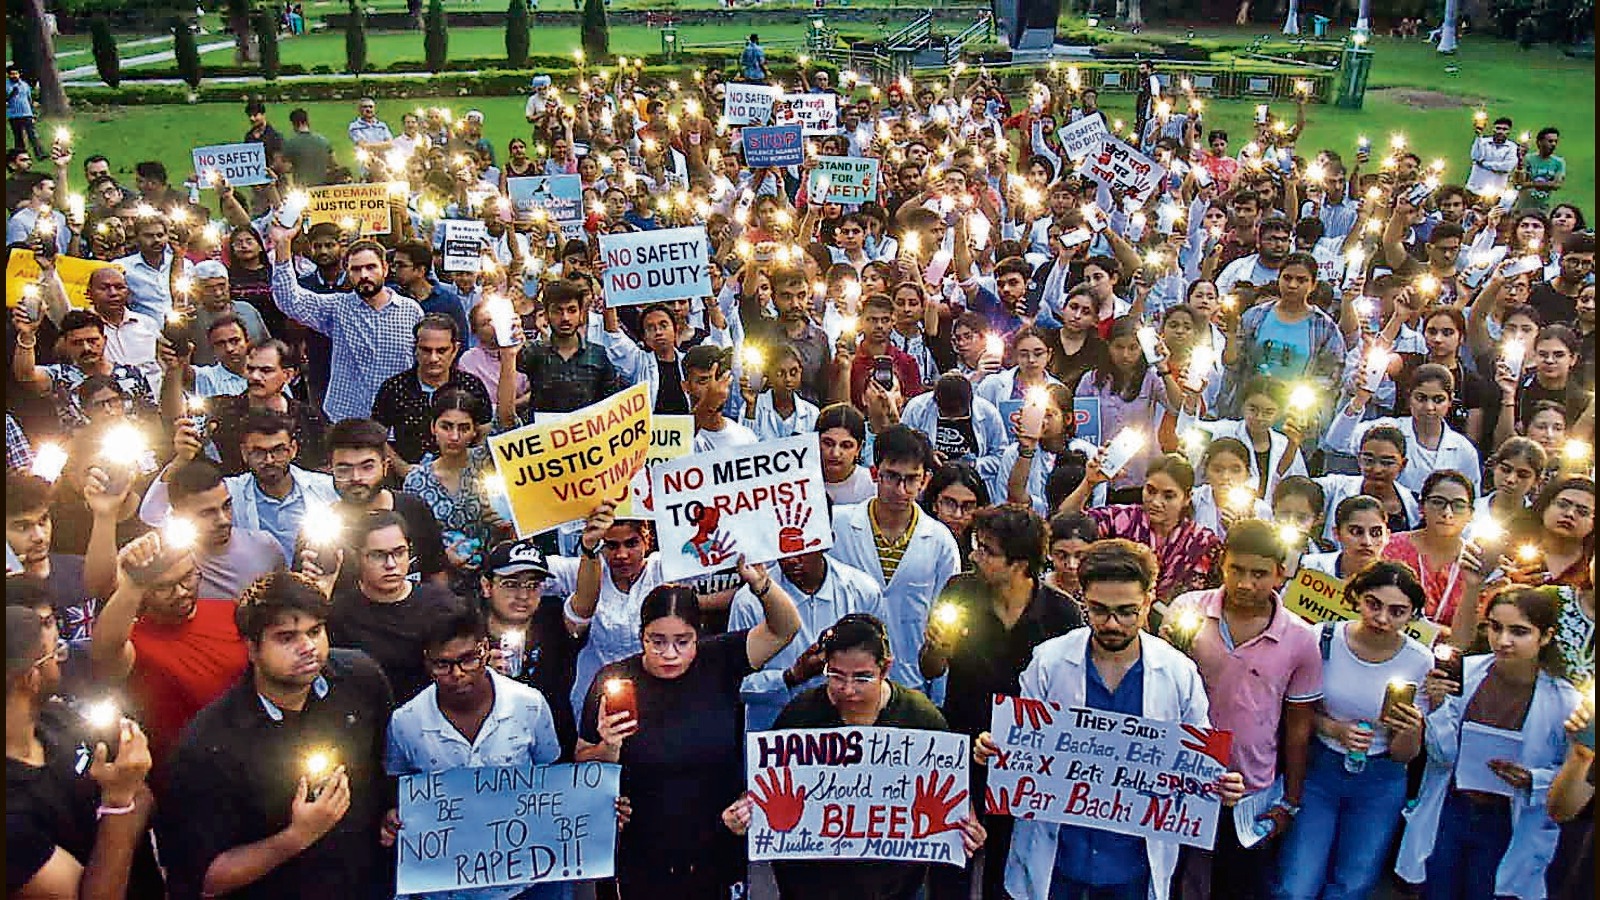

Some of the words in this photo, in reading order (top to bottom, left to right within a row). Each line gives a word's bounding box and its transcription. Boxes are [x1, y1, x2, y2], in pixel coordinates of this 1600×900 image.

[729, 91, 743, 104] NO
[729, 106, 746, 117] NO
[749, 131, 797, 149] STOP
[1076, 121, 1101, 138] SAFETY
[199, 155, 216, 166] NO
[218, 150, 260, 165] SAFETY
[226, 164, 261, 179] DUTY
[819, 160, 852, 172] STAND
[855, 163, 870, 173] UP
[826, 184, 871, 198] AFETY
[831, 173, 853, 183] FOR
[309, 189, 330, 199] WE
[333, 187, 387, 198] DEMAND
[314, 199, 356, 212] JUSTIC
[360, 199, 385, 210] FOR
[607, 248, 632, 268] NO
[636, 240, 699, 264] SAFETY
[611, 271, 641, 292] NO
[647, 264, 700, 288] DUTY
[500, 434, 544, 462] WE
[550, 393, 646, 449] DEMAND
[515, 446, 604, 486] JUSTIC
[608, 419, 647, 457] FOR
[552, 457, 629, 502] VICTIM
[664, 467, 705, 495] NO
[712, 447, 808, 486] MERCY
[666, 500, 704, 528] TO
[714, 478, 810, 516] RAPIST
[1069, 707, 1118, 733] THEY
[1122, 716, 1166, 740] SAID:
[757, 731, 864, 769] HANDS
[869, 732, 914, 768] that
[918, 736, 965, 770] heal
[1007, 725, 1045, 750] Beti
[1126, 741, 1166, 767] Beti
[405, 769, 447, 801] WE
[474, 765, 550, 794] WANT
[571, 763, 602, 788] TO
[1065, 760, 1104, 784] Beti
[882, 773, 912, 801] not
[436, 797, 464, 822] BE
[514, 792, 563, 818] SAFE
[1011, 776, 1057, 811] Par
[1063, 781, 1134, 822] Bachi
[1140, 796, 1203, 838] Nahi
[819, 804, 931, 840] BLEED
[399, 827, 456, 862] NOT
[486, 818, 528, 850] TO
[555, 814, 591, 842] BE
[755, 828, 824, 855] #Justice
[830, 835, 854, 857] for
[860, 838, 951, 862] MOUMITA
[455, 840, 583, 886] RAPED!!
